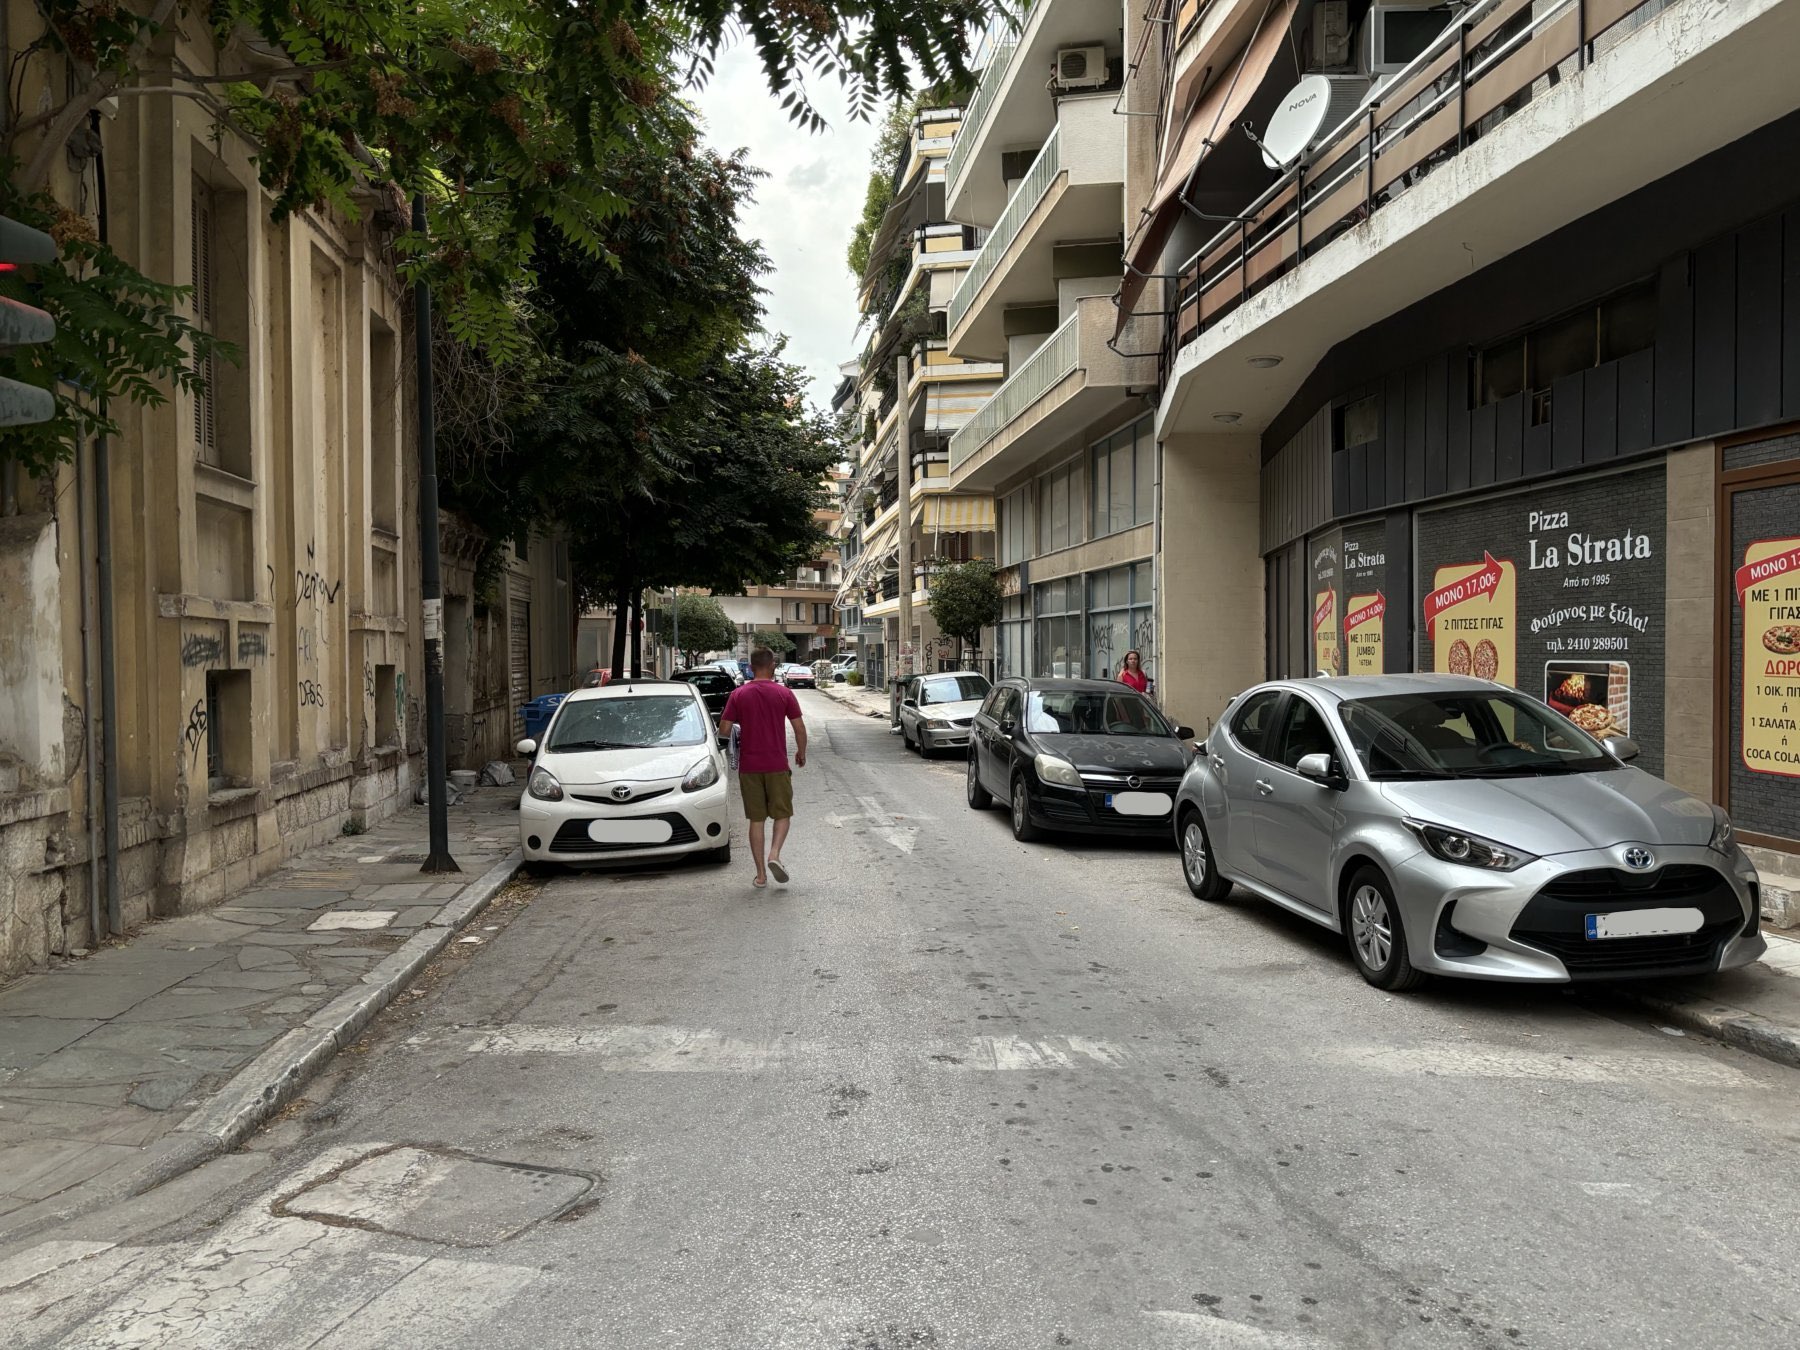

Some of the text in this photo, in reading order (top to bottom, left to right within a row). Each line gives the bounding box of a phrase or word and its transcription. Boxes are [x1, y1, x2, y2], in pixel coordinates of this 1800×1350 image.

[1289, 93, 1317, 111] NOVA
[1529, 510, 1569, 532] Pizza
[1344, 541, 1359, 552] Pizza
[1528, 528, 1652, 570] La Strata
[1345, 554, 1356, 570] La
[1358, 550, 1385, 568] Strata
[1750, 557, 1787, 580] ΜΟΝΟ
[1563, 576, 1580, 587] Από
[1592, 574, 1610, 586] 1995
[1435, 572, 1497, 609] ΜΟΝΟ 17,00€
[1751, 587, 1800, 602] ΜΕ 1 ΠΙ
[1350, 610, 1366, 626] ΜΟΝΟ
[1444, 617, 1504, 631] 2 ΠΙΤΣΕΣ ΓΙΓΑΣ
[1530, 602, 1649, 634] Φούρνος με ξύλα!
[1356, 646, 1376, 657] JUMBO
[1546, 637, 1629, 653] τηλ. 2410 289501
[1764, 686, 1783, 697] ΟΙΚ.
[1759, 717, 1797, 730] ΣΑΛΑΤΑ
[1746, 748, 1772, 760] COCA
